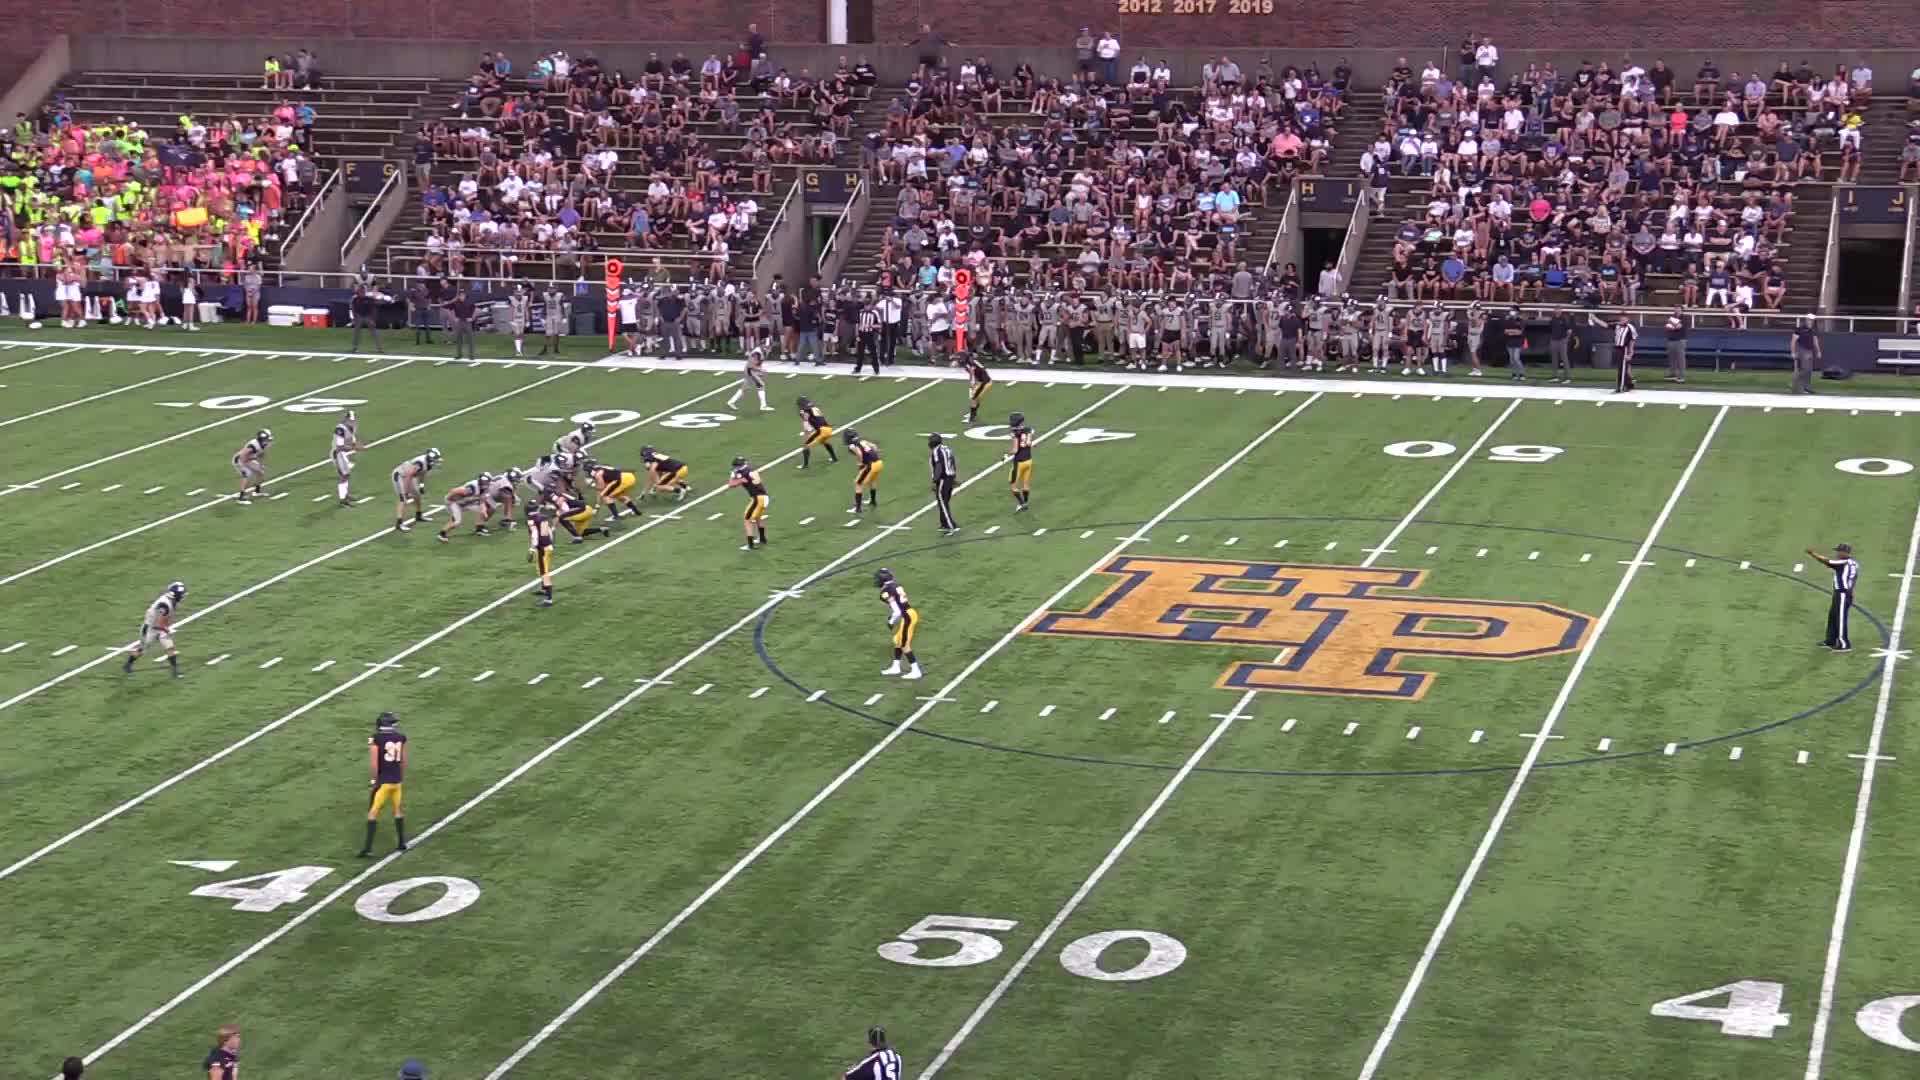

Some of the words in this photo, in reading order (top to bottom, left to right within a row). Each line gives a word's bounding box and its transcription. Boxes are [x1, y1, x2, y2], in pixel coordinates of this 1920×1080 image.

[1118, 0, 1162, 13] 2012
[1173, 0, 1216, 13] 2017
[1228, 0, 1274, 14] 2019
[346, 162, 357, 175] F
[806, 172, 819, 186] G
[845, 172, 857, 186] H
[1302, 182, 1314, 195] H
[1891, 191, 1904, 205] J
[384, 741, 402, 762] 31
